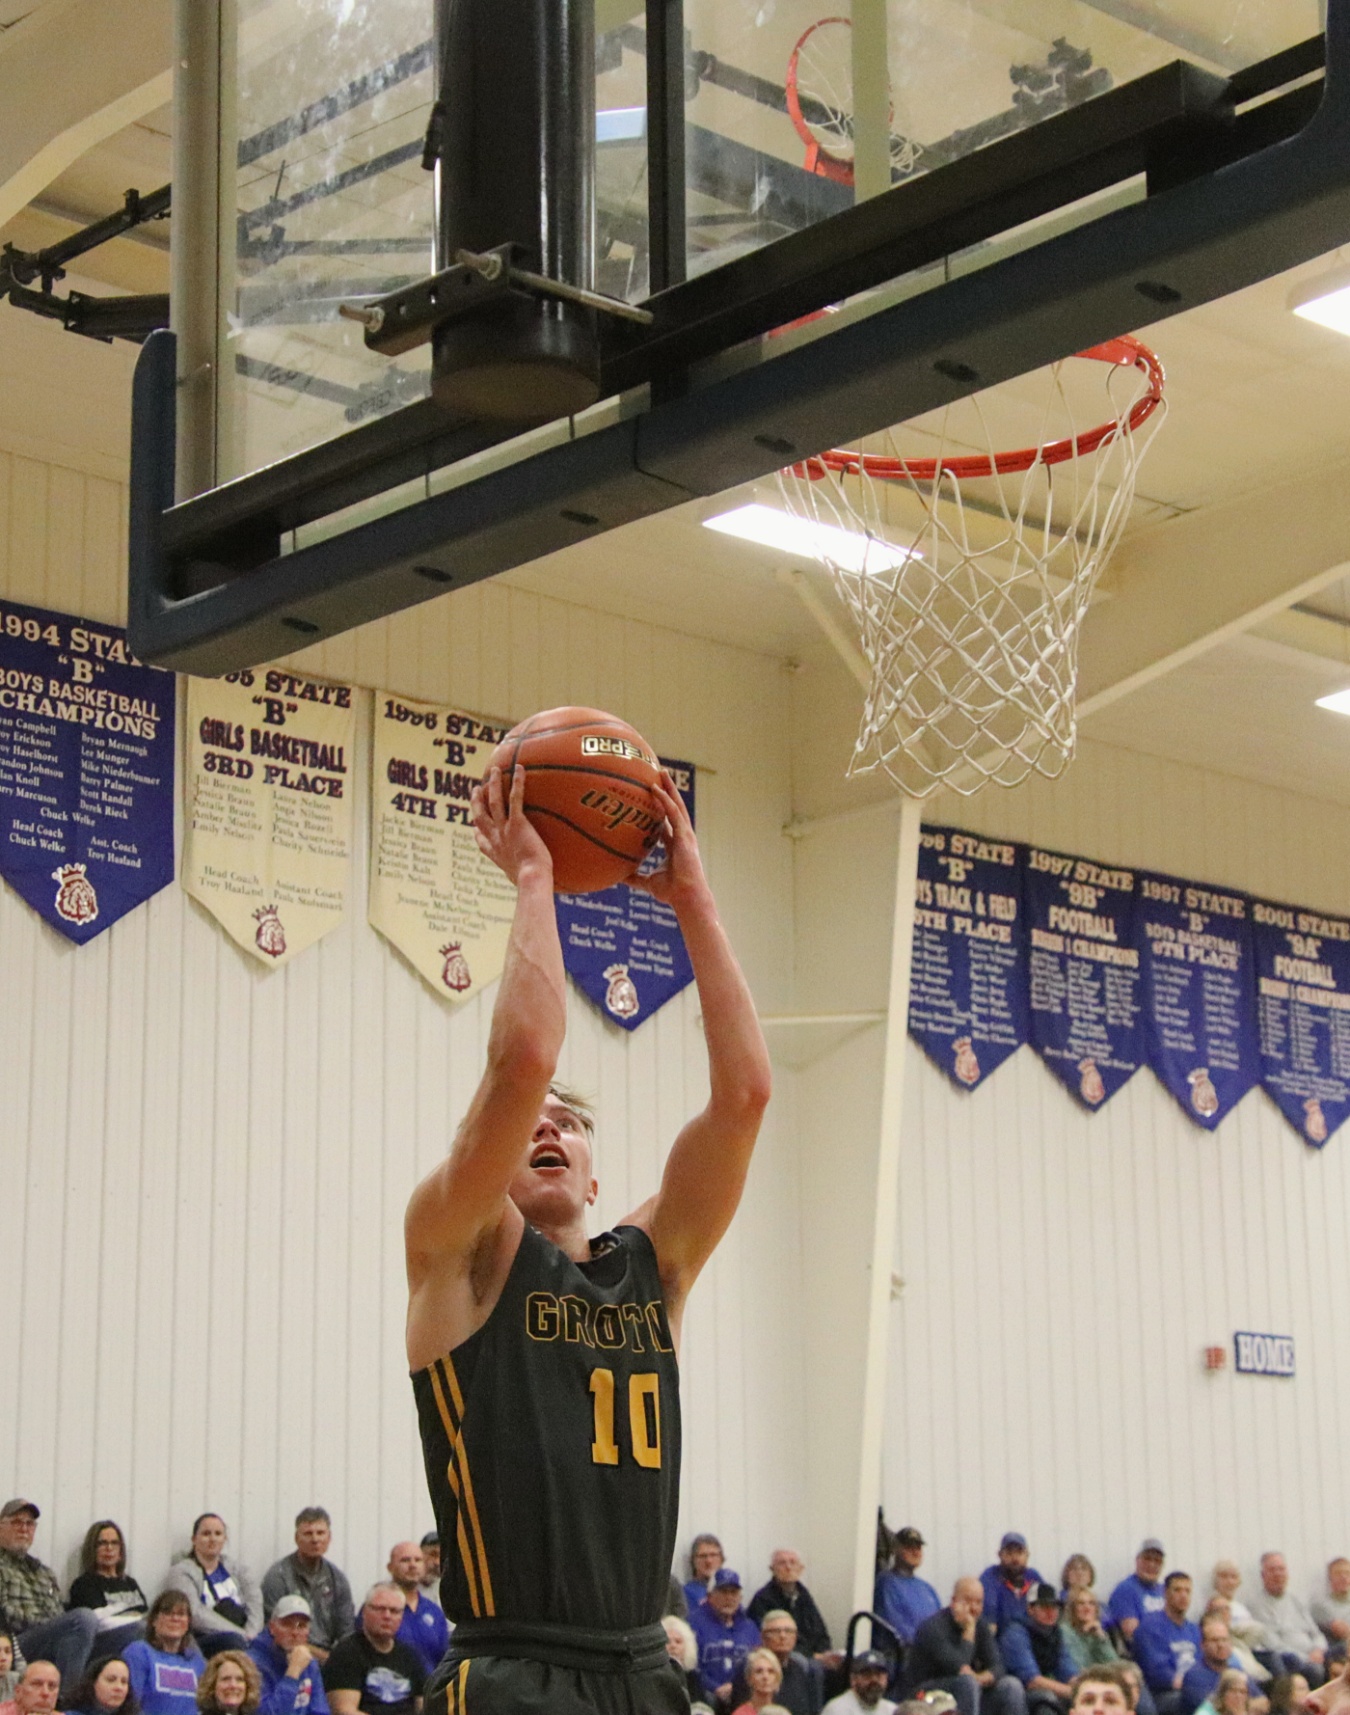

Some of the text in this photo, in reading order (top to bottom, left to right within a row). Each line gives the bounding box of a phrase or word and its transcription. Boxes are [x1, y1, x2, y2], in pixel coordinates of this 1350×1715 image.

[50, 680, 161, 721] BASKETBALL
[265, 669, 351, 709] STATE
[0, 689, 155, 740] CHAMPIONS
[446, 713, 509, 745] STA
[200, 716, 347, 774] GIRLS BASKETBALL
[203, 751, 343, 798] 3RD PLACE
[387, 757, 428, 791] GIRLS
[391, 792, 437, 819] 4TH
[12, 819, 63, 839] Head Coach
[951, 834, 1015, 866] STATE
[1029, 849, 1134, 891] 1997 STATE
[1186, 887, 1245, 919] STATE
[952, 915, 1012, 944] PLACE
[1048, 904, 1118, 942] FOOTBALL
[1298, 913, 1350, 941] STATE
[1188, 945, 1238, 972] PLACE
[1274, 954, 1337, 989] FOOTBALL
[1238, 1334, 1294, 1374] HOME
[589, 1367, 661, 1470] 10
